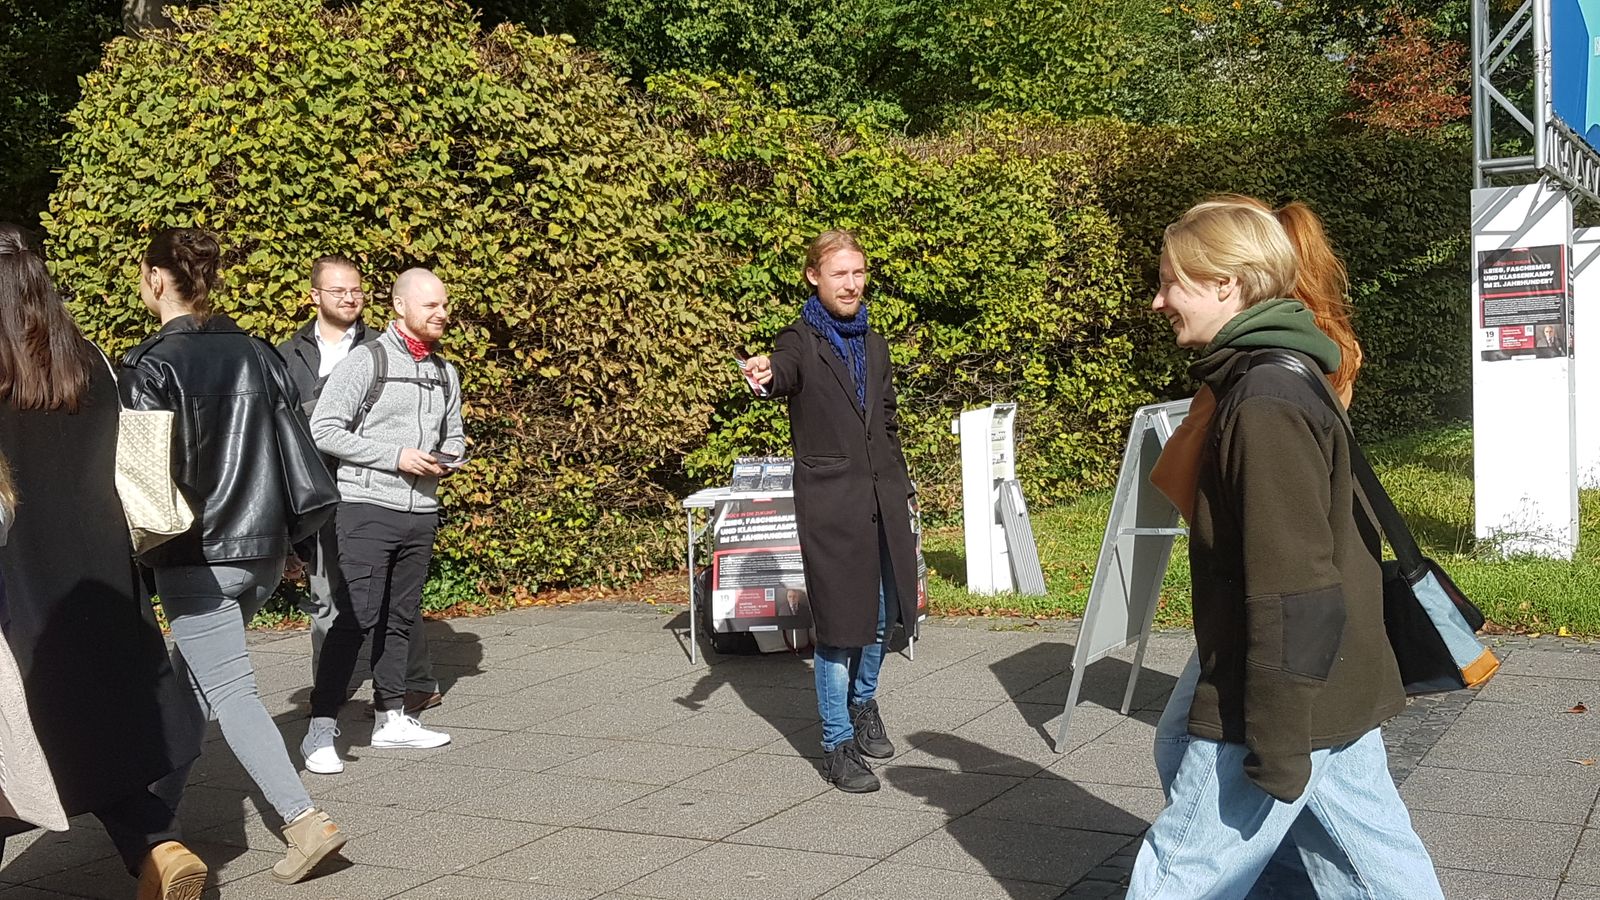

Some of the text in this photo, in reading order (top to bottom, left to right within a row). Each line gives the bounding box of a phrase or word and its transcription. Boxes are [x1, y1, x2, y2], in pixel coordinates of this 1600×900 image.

[1506, 264, 1551, 272] FASCHISMUS
[1500, 271, 1554, 280] KLASSENKAMPF
[1503, 278, 1553, 287] JAHRHUNDERT
[746, 515, 795, 524] FASCHISMUS
[740, 531, 797, 542] JAHRHUNDERT
